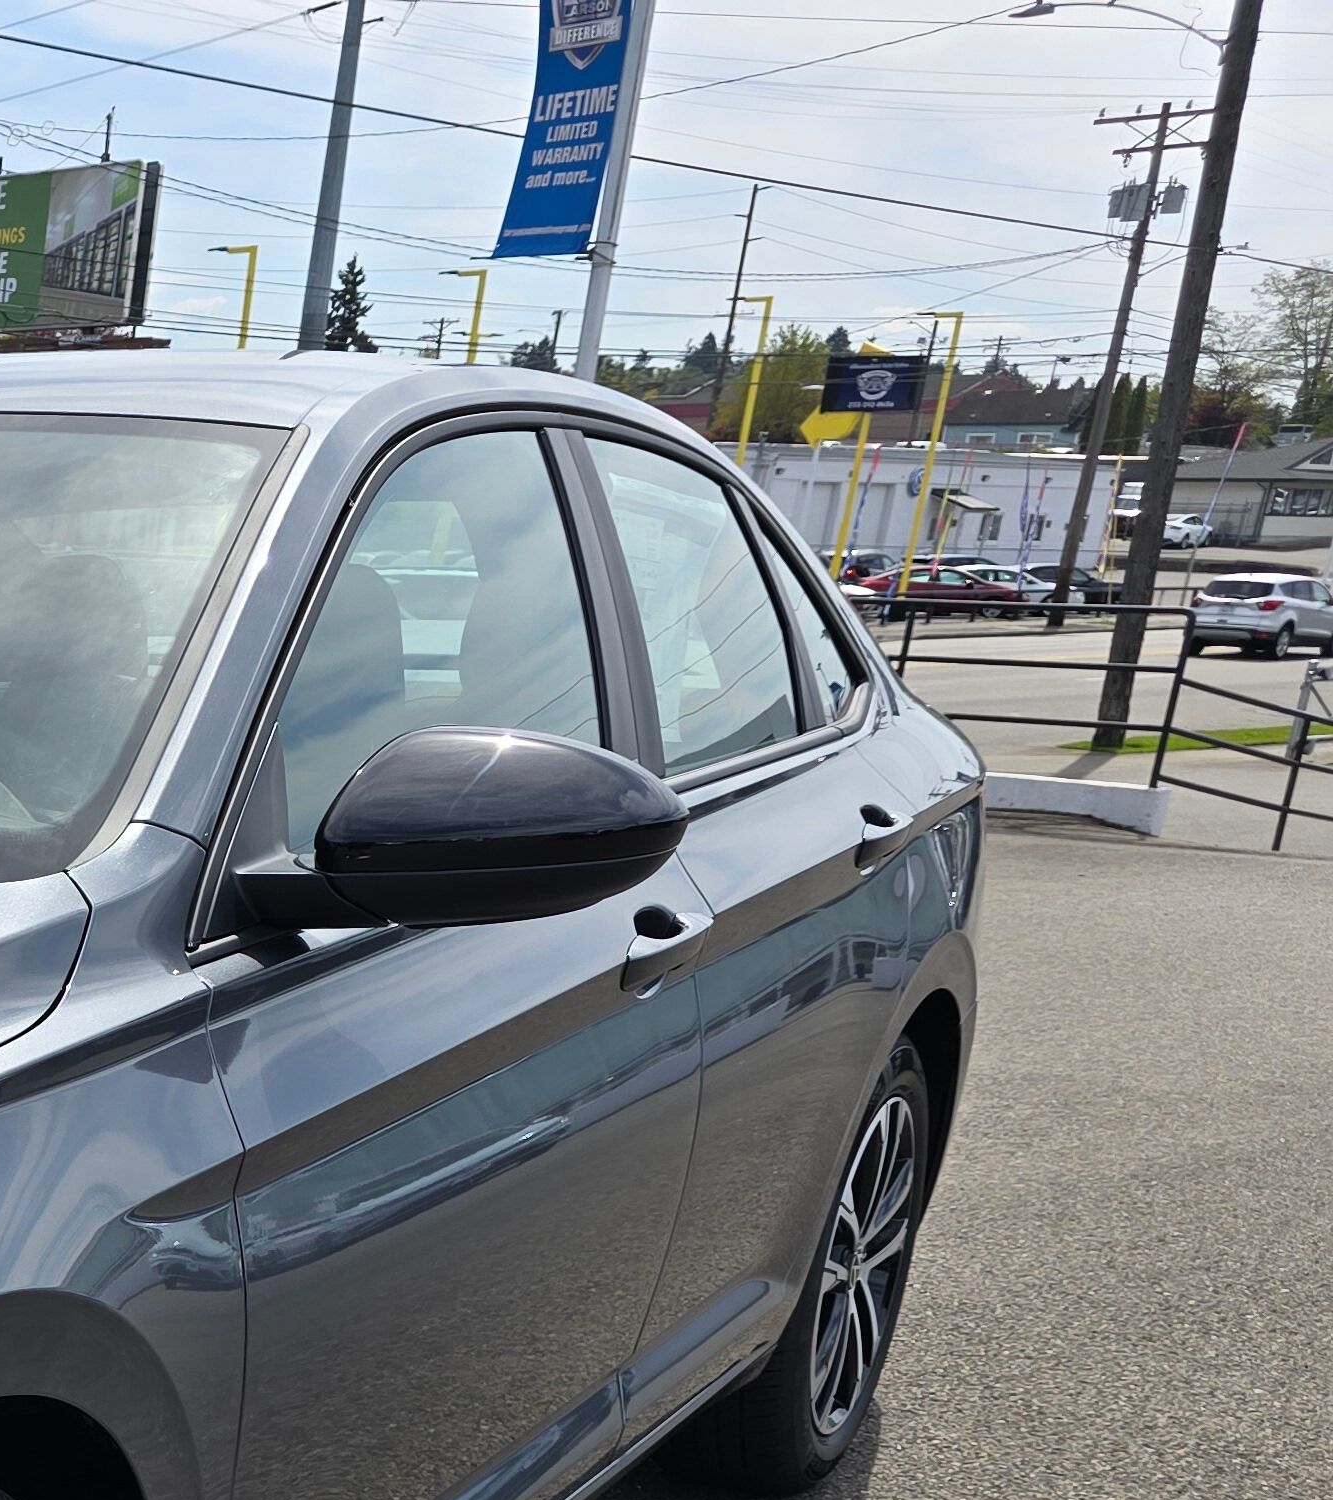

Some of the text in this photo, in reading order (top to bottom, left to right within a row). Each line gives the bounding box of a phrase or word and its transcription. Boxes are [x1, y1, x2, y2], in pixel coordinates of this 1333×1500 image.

[555, 22, 618, 45] DIFFERENCE
[534, 84, 619, 123] LIFETIME
[545, 120, 599, 143] LIMITED
[532, 142, 605, 167] WARRANTY
[525, 170, 549, 189] and
